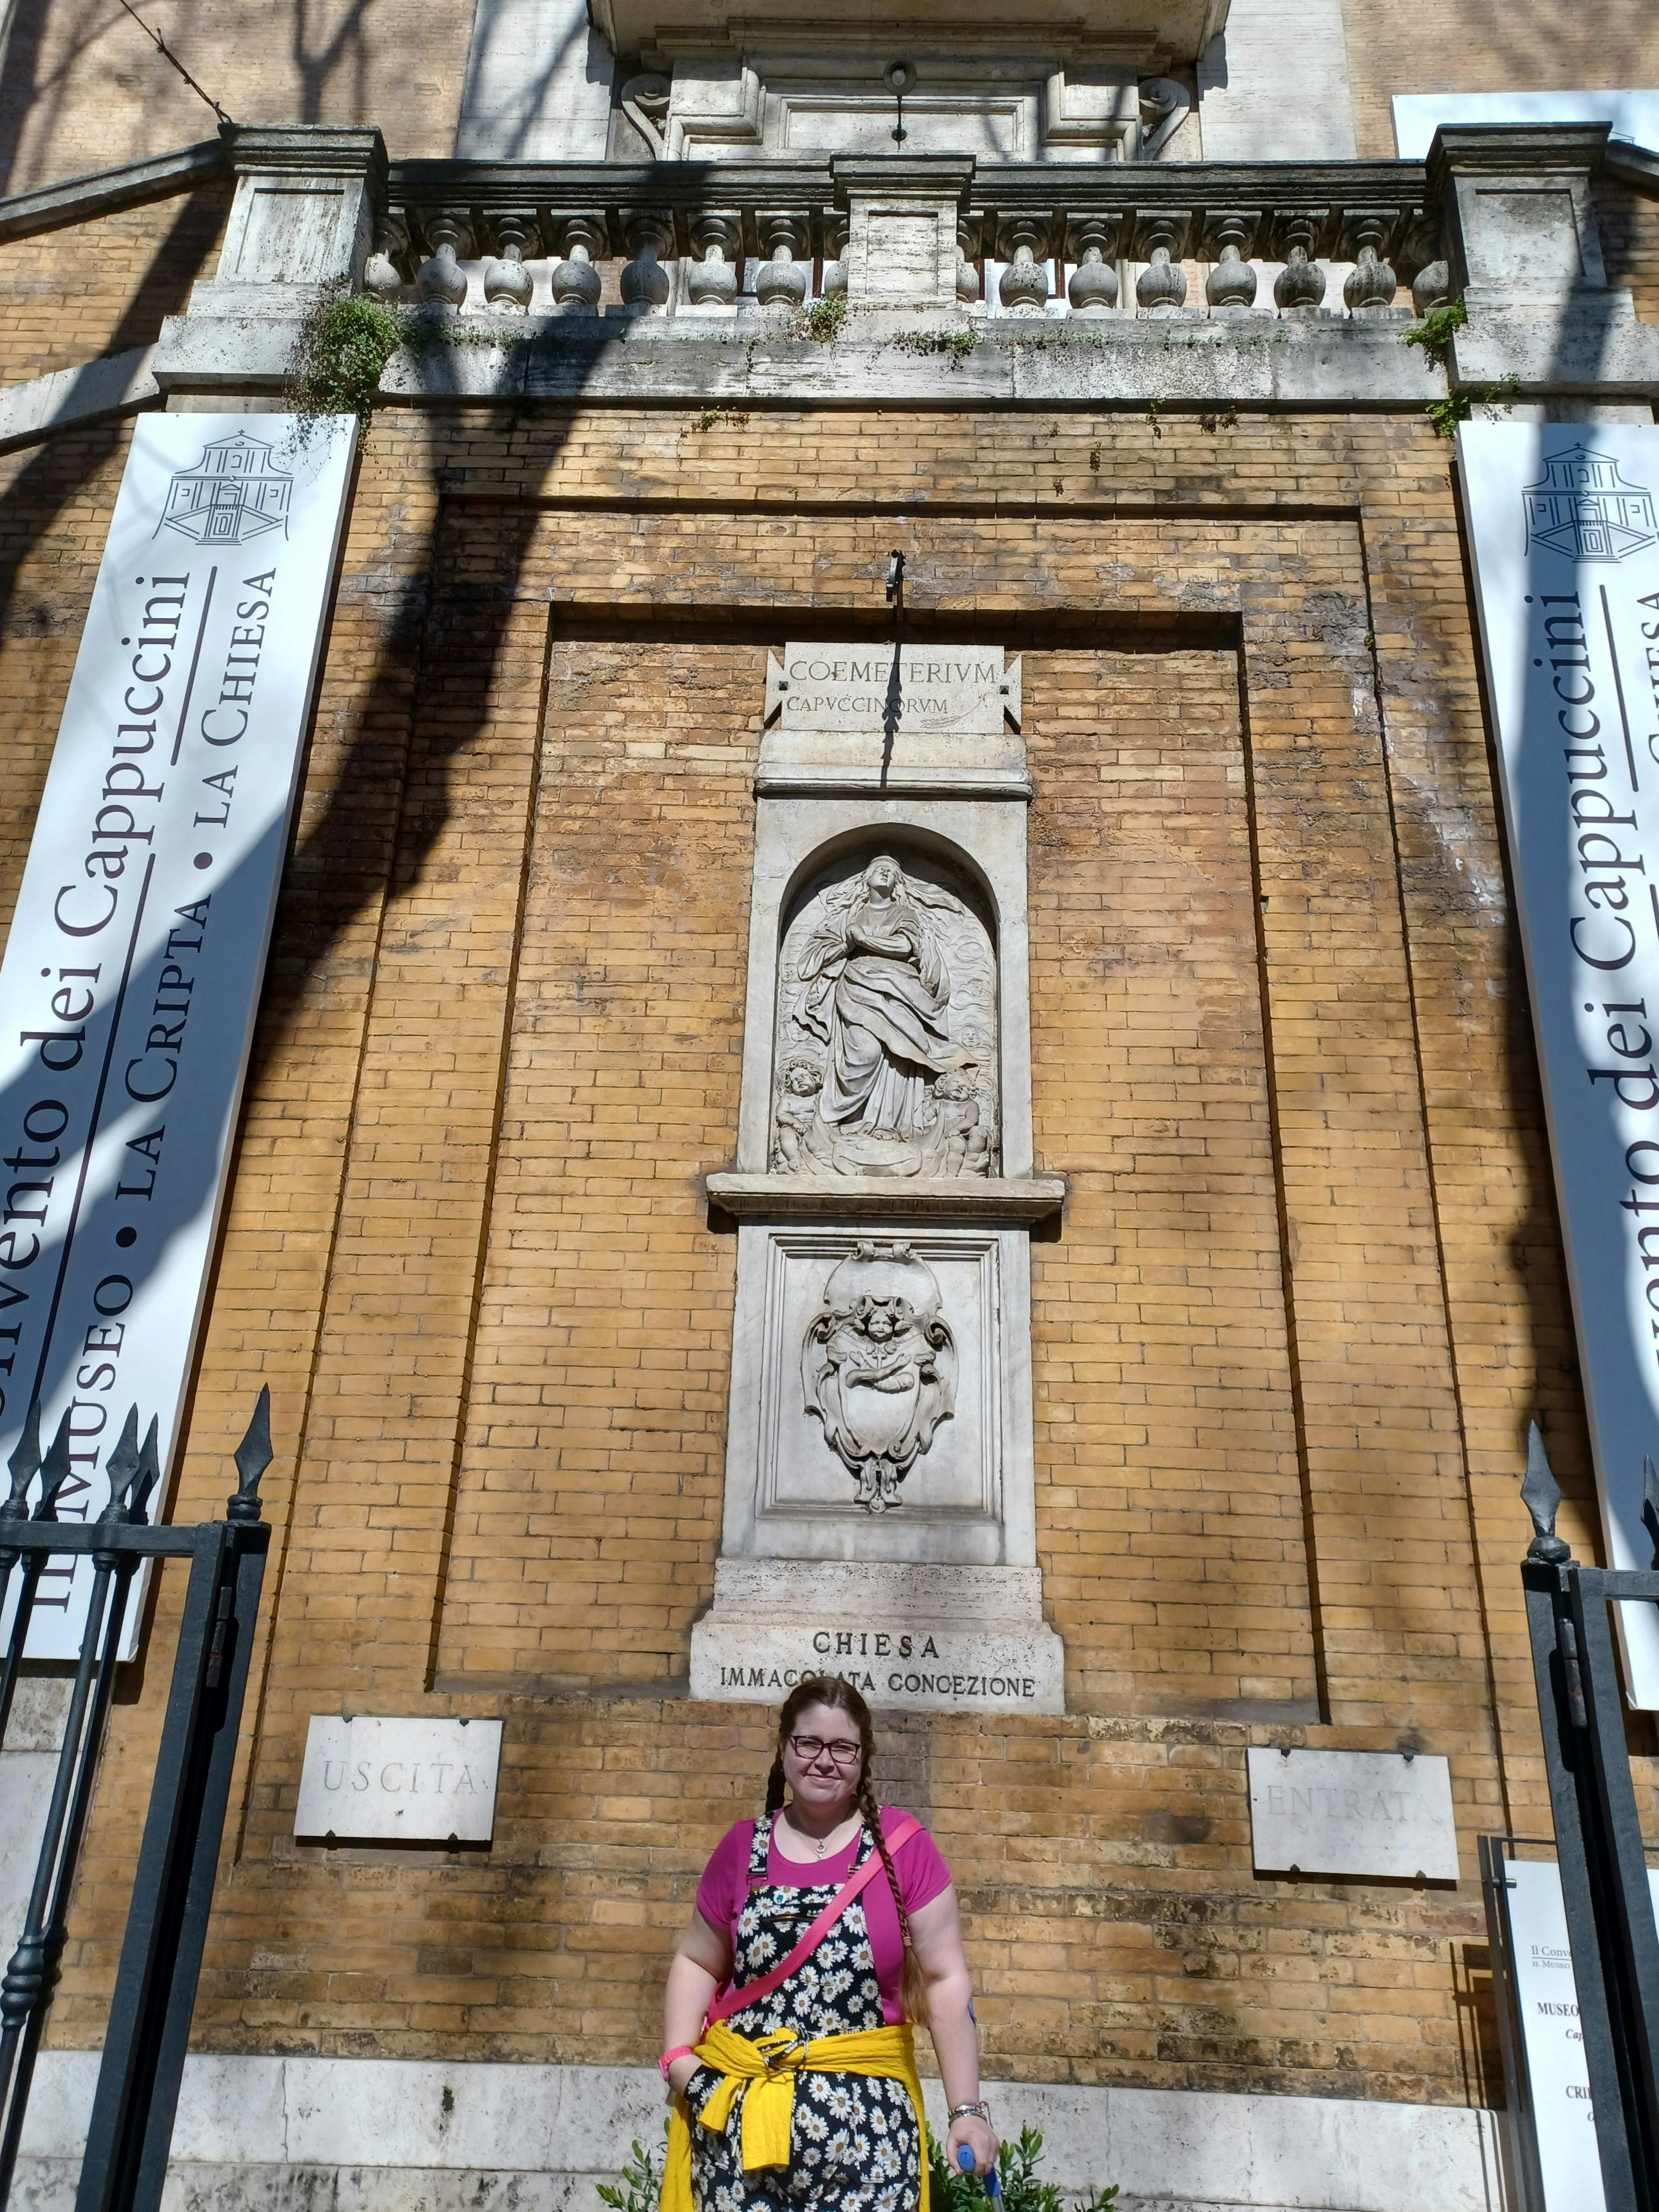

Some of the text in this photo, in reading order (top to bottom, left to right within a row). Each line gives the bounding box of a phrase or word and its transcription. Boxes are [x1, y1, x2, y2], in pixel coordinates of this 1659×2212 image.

[201, 567, 277, 747] CHIESA
[789, 660, 996, 684] COEMETERIVM
[786, 696, 948, 714] CAPVCCINORVM
[54, 571, 190, 937] Cappuccini
[194, 764, 238, 829] LA
[1525, 591, 1646, 971] Cappuccini
[20, 963, 102, 1072] dei
[124, 894, 212, 1103] CRIPTA
[1584, 998, 1659, 1110] dei
[115, 1124, 166, 1202] LA
[812, 1631, 940, 1658] CHIESA
[888, 1673, 1036, 1698] CONCEZIONE
[323, 1760, 477, 1794] USCITA
[1265, 1785, 1443, 1823] ENTRATA
[1531, 1945, 1539, 1955] Il
[1542, 1960, 1571, 1969] MUSEO
[1537, 2002, 1580, 2017] MUSEO
